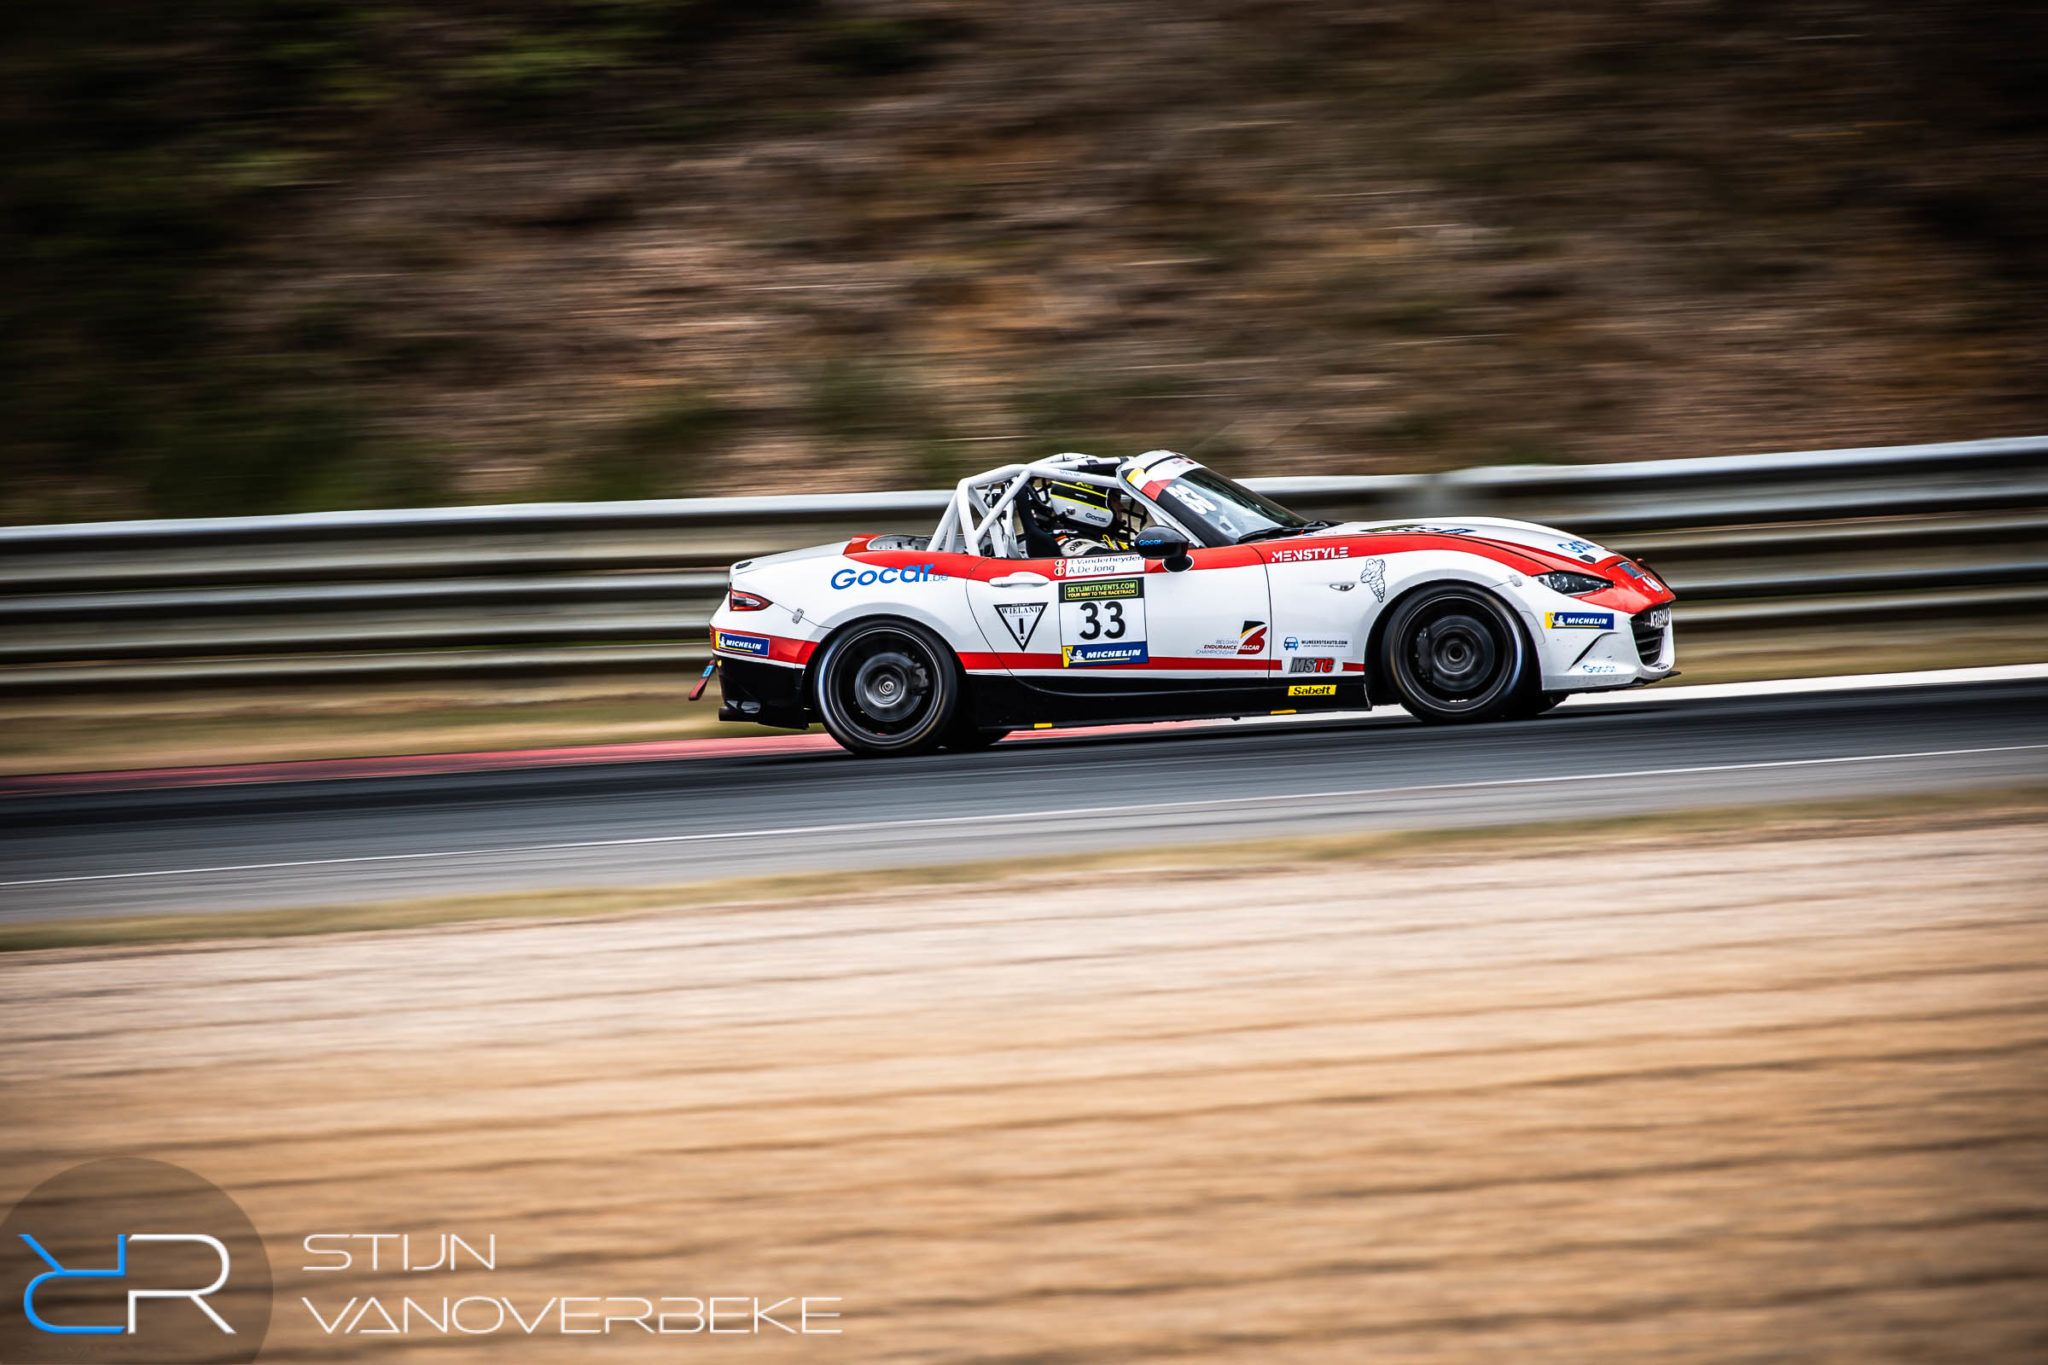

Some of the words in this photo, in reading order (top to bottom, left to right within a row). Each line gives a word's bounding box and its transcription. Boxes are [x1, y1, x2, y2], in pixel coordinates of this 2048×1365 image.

[1271, 546, 1349, 563] MENSTYLE
[1093, 564, 1115, 573] Jong
[1067, 582, 1136, 593] SKYLIMITEVENTS.COM
[1001, 606, 1041, 614] WIELAND
[1079, 601, 1126, 640] 33
[1566, 617, 1608, 625] MICHELIN
[725, 639, 762, 650] MICHELIN
[1086, 648, 1142, 659] MICHELIN
[1289, 657, 1335, 674] MSTC
[1293, 686, 1331, 696] Sabelt
